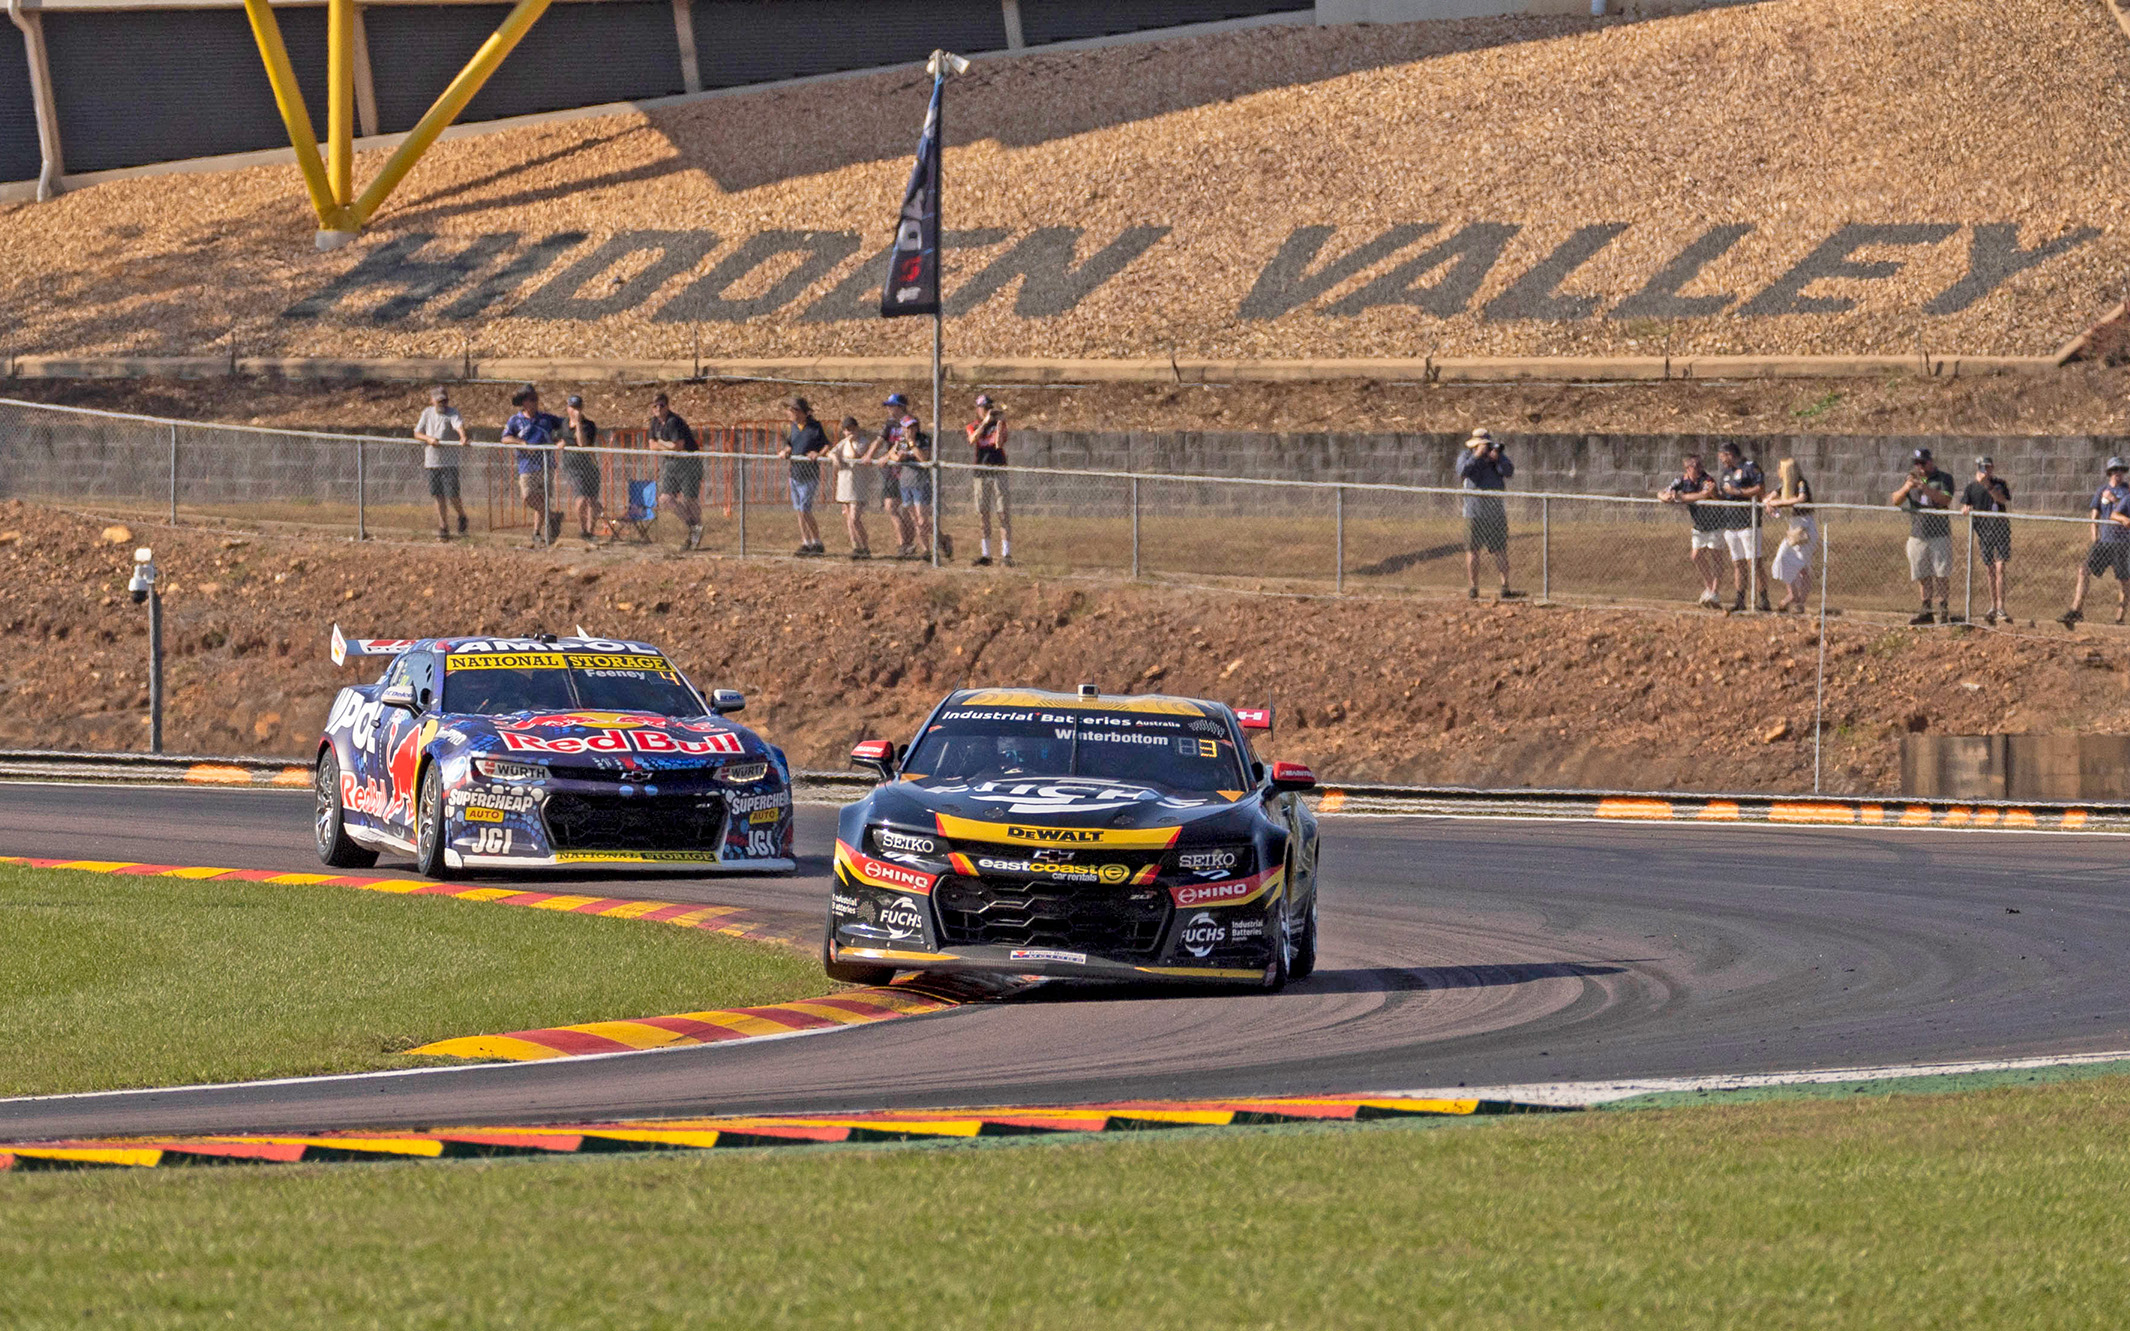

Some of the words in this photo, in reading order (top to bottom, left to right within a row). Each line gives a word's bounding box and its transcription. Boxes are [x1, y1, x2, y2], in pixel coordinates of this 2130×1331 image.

[1237, 221, 2102, 321] VALLEY
[454, 640, 658, 655] AMPOL
[450, 655, 559, 668] NATIONAL
[572, 655, 667, 669] STORAGE
[584, 669, 646, 680] Feeney
[942, 710, 1034, 722] Industrial
[1135, 719, 1181, 728] Australia
[497, 729, 632, 754] Red
[628, 729, 746, 755] Bull
[1055, 728, 1169, 746] Winterbottom
[448, 788, 535, 813] SUPERCHEAP
[469, 809, 501, 819] AUTO
[752, 809, 775, 820] AUTO
[471, 827, 513, 855] JGI
[745, 830, 776, 857] JGI
[882, 835, 934, 853] SEIKO
[559, 851, 638, 860] NATIONAL
[645, 852, 713, 861] STORAGE
[1179, 853, 1235, 867] SEIKO
[881, 867, 928, 888] HINO
[1051, 872, 1068, 880] car
[1067, 873, 1097, 882] rentals
[1198, 883, 1247, 899] HINO
[880, 909, 922, 928] FUCHS
[1232, 920, 1263, 928] Industrial
[1180, 928, 1225, 944] FUCHS
[1232, 929, 1262, 937] Batteries
